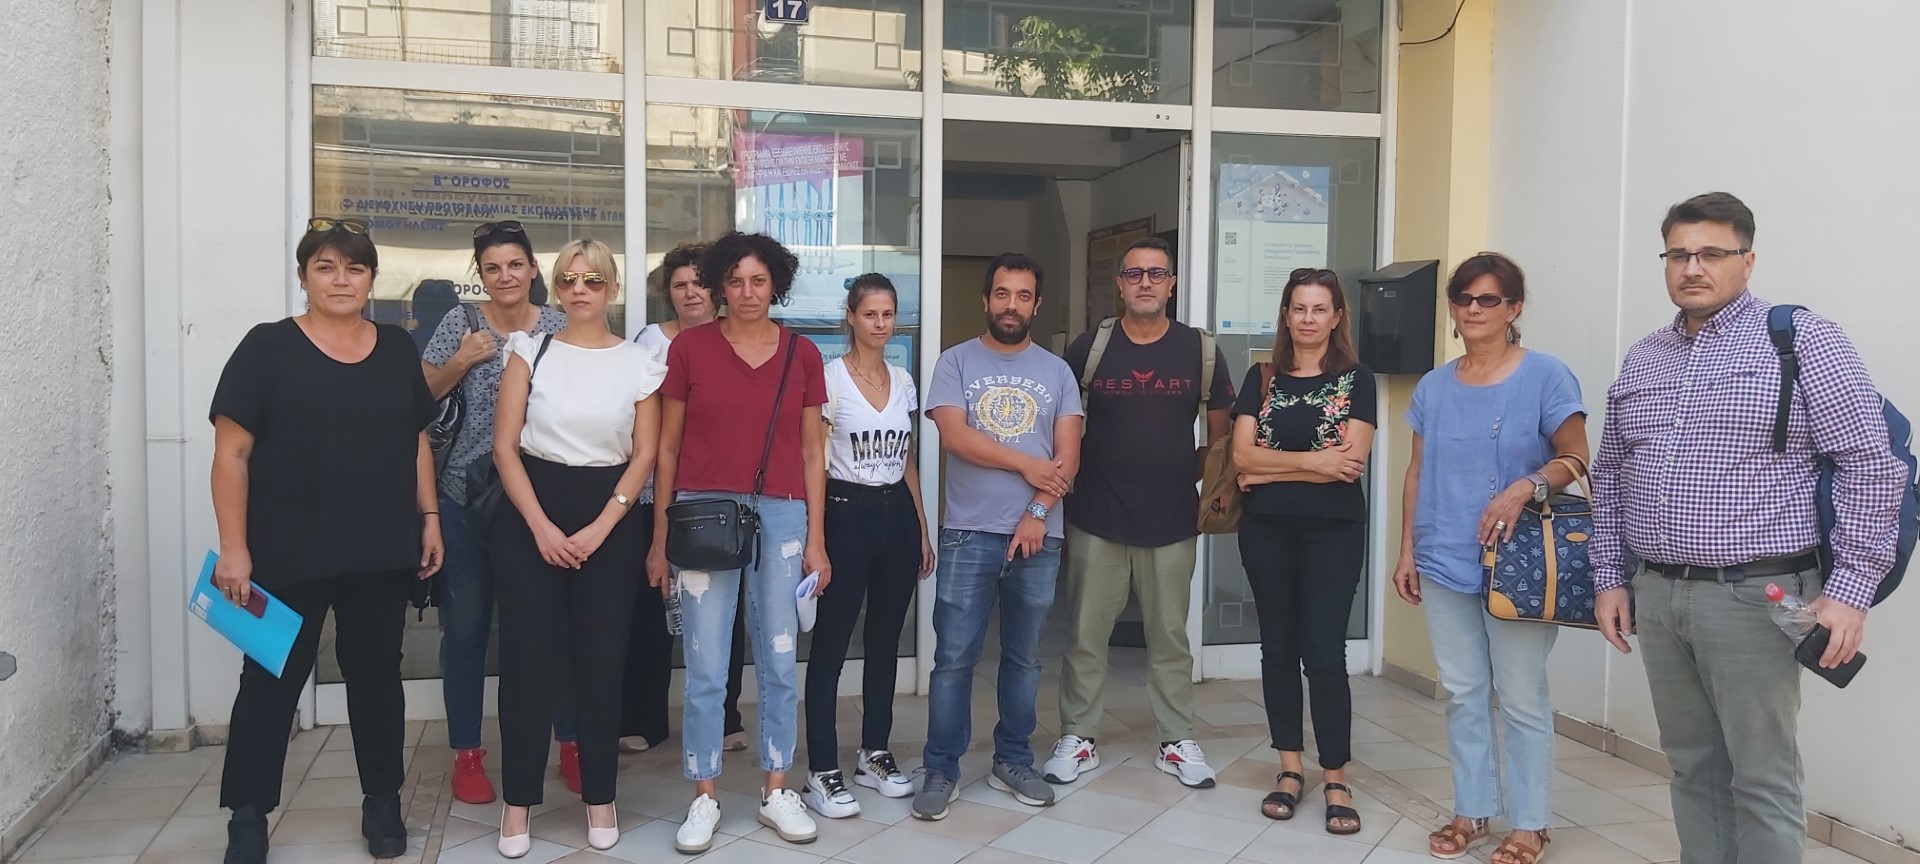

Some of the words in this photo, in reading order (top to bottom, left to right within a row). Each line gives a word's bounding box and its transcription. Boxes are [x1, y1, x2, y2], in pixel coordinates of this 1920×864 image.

[772, 0, 803, 19] 17
[451, 175, 510, 189] ΟΡΟΦΟΣ
[367, 218, 400, 230] ΟΜΟΥ
[1094, 378, 1193, 390] RESTART
[849, 429, 911, 462] MAGIC
